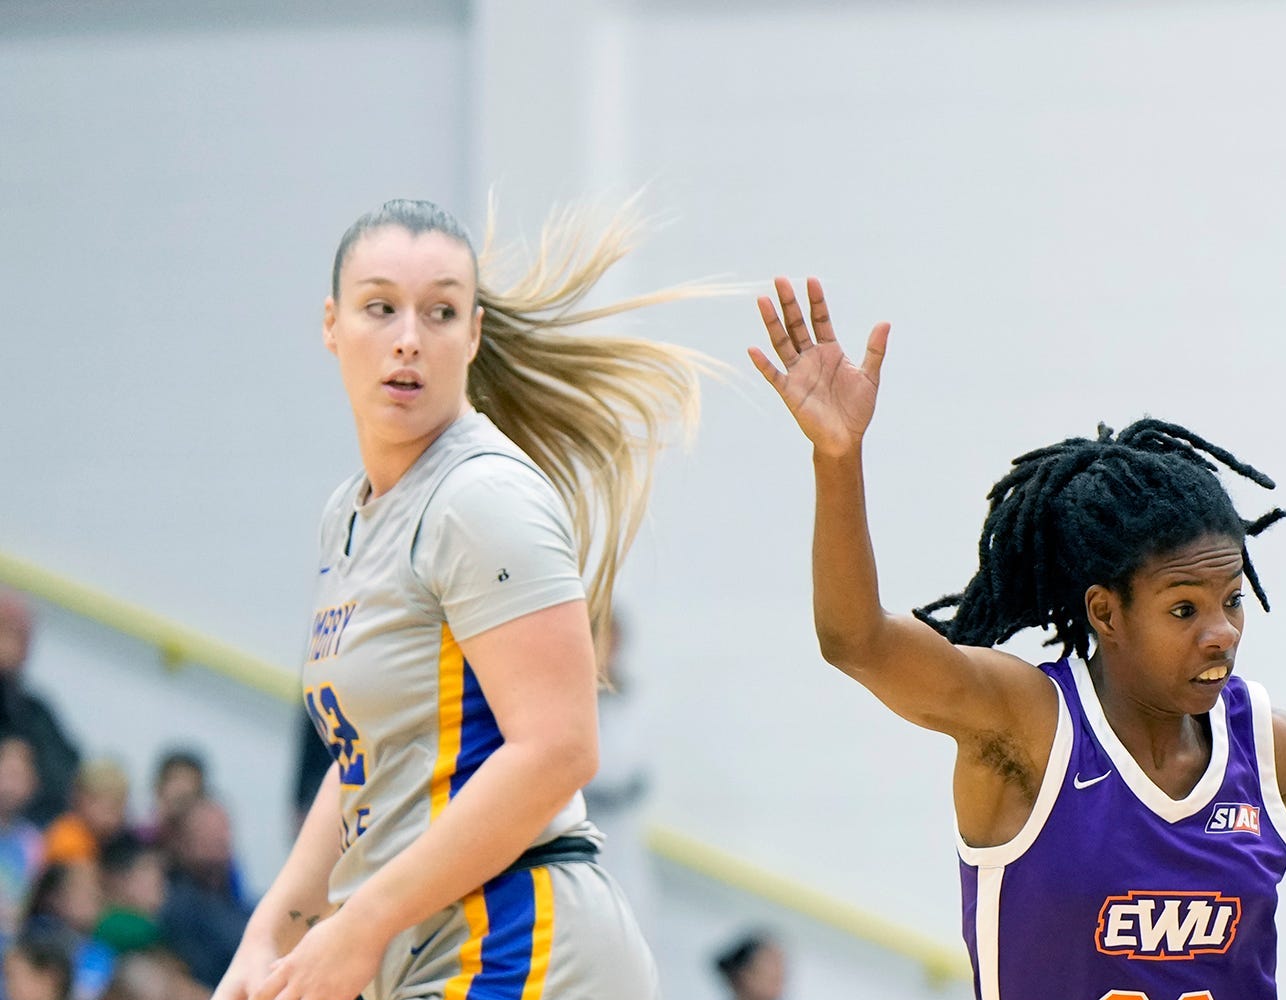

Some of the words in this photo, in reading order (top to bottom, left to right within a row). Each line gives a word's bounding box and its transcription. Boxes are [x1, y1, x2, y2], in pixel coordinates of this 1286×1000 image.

[304, 601, 357, 663] MBRY
[1210, 807, 1260, 832] SIAC
[1103, 899, 1232, 952] EWU
